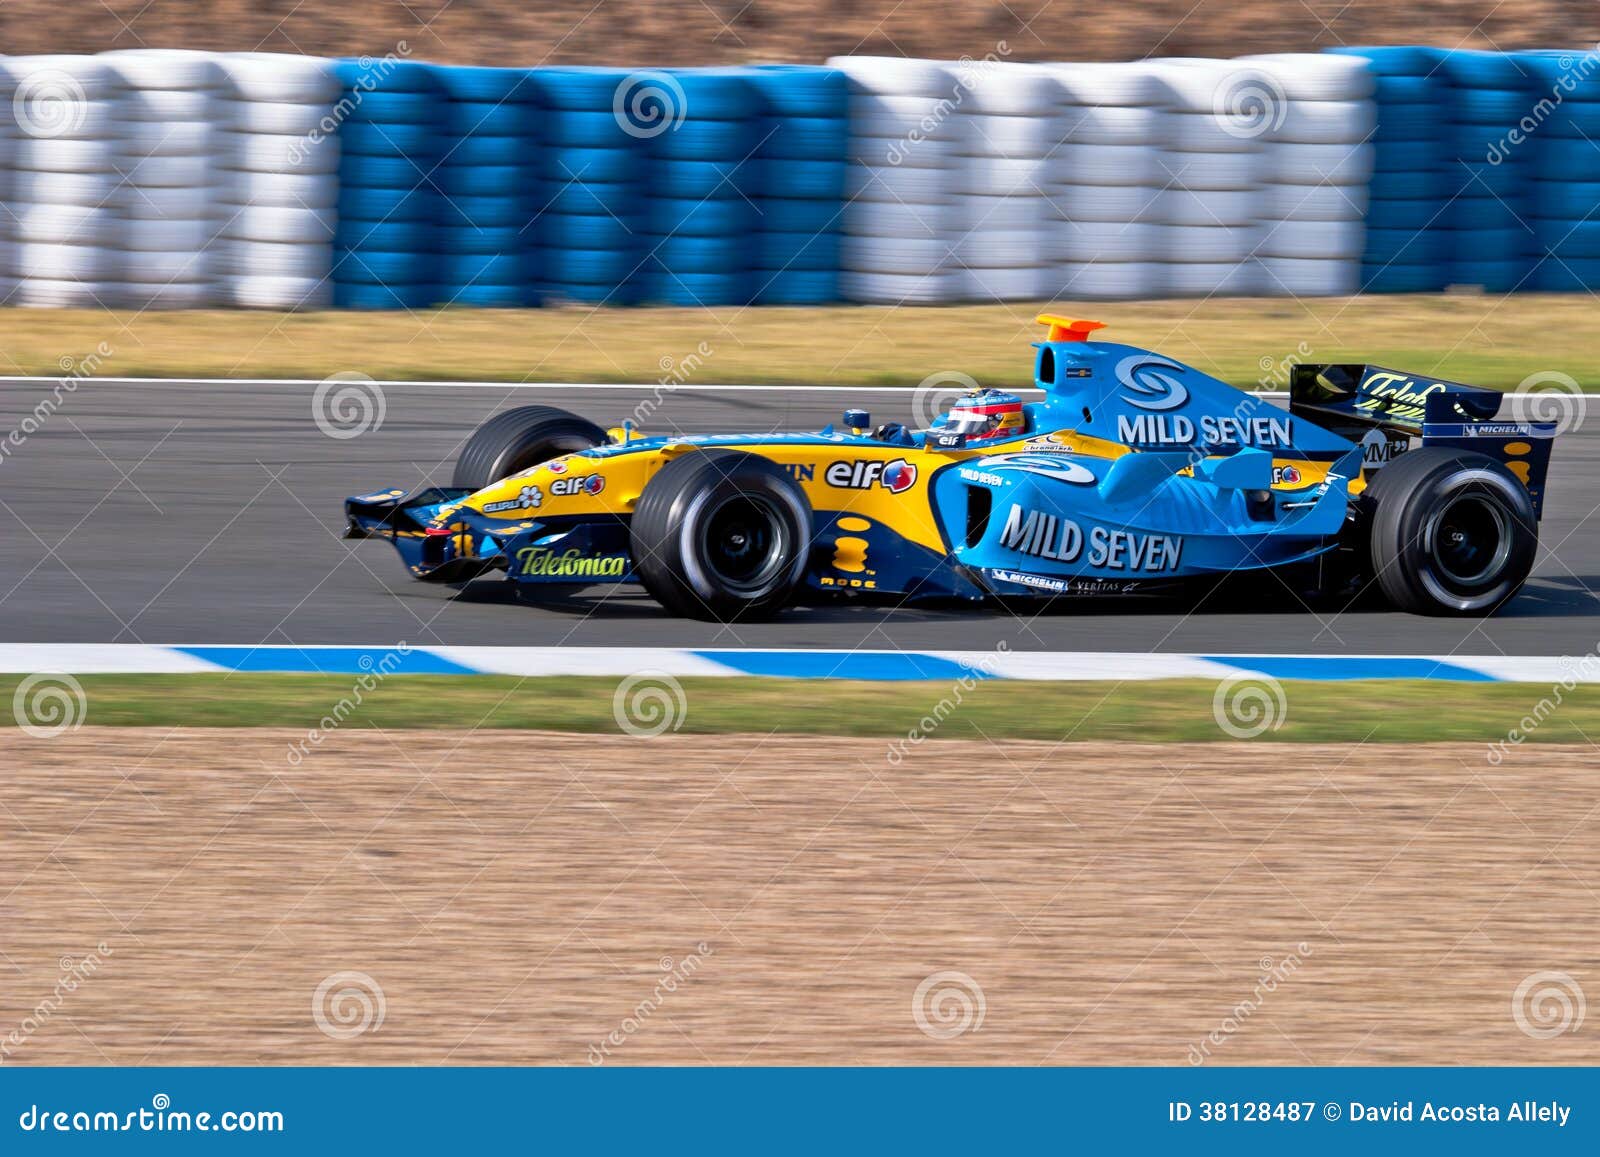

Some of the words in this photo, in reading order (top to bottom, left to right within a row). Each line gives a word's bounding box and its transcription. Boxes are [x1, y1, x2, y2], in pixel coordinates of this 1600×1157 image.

[1117, 414, 1195, 444] MILD
[1200, 415, 1291, 446] SEVEN
[1478, 425, 1528, 434] MICHELIN
[551, 478, 584, 496] elf
[999, 503, 1082, 561] MILD
[1088, 526, 1183, 571] SEVEN
[1009, 573, 1065, 590] MICHELIN
